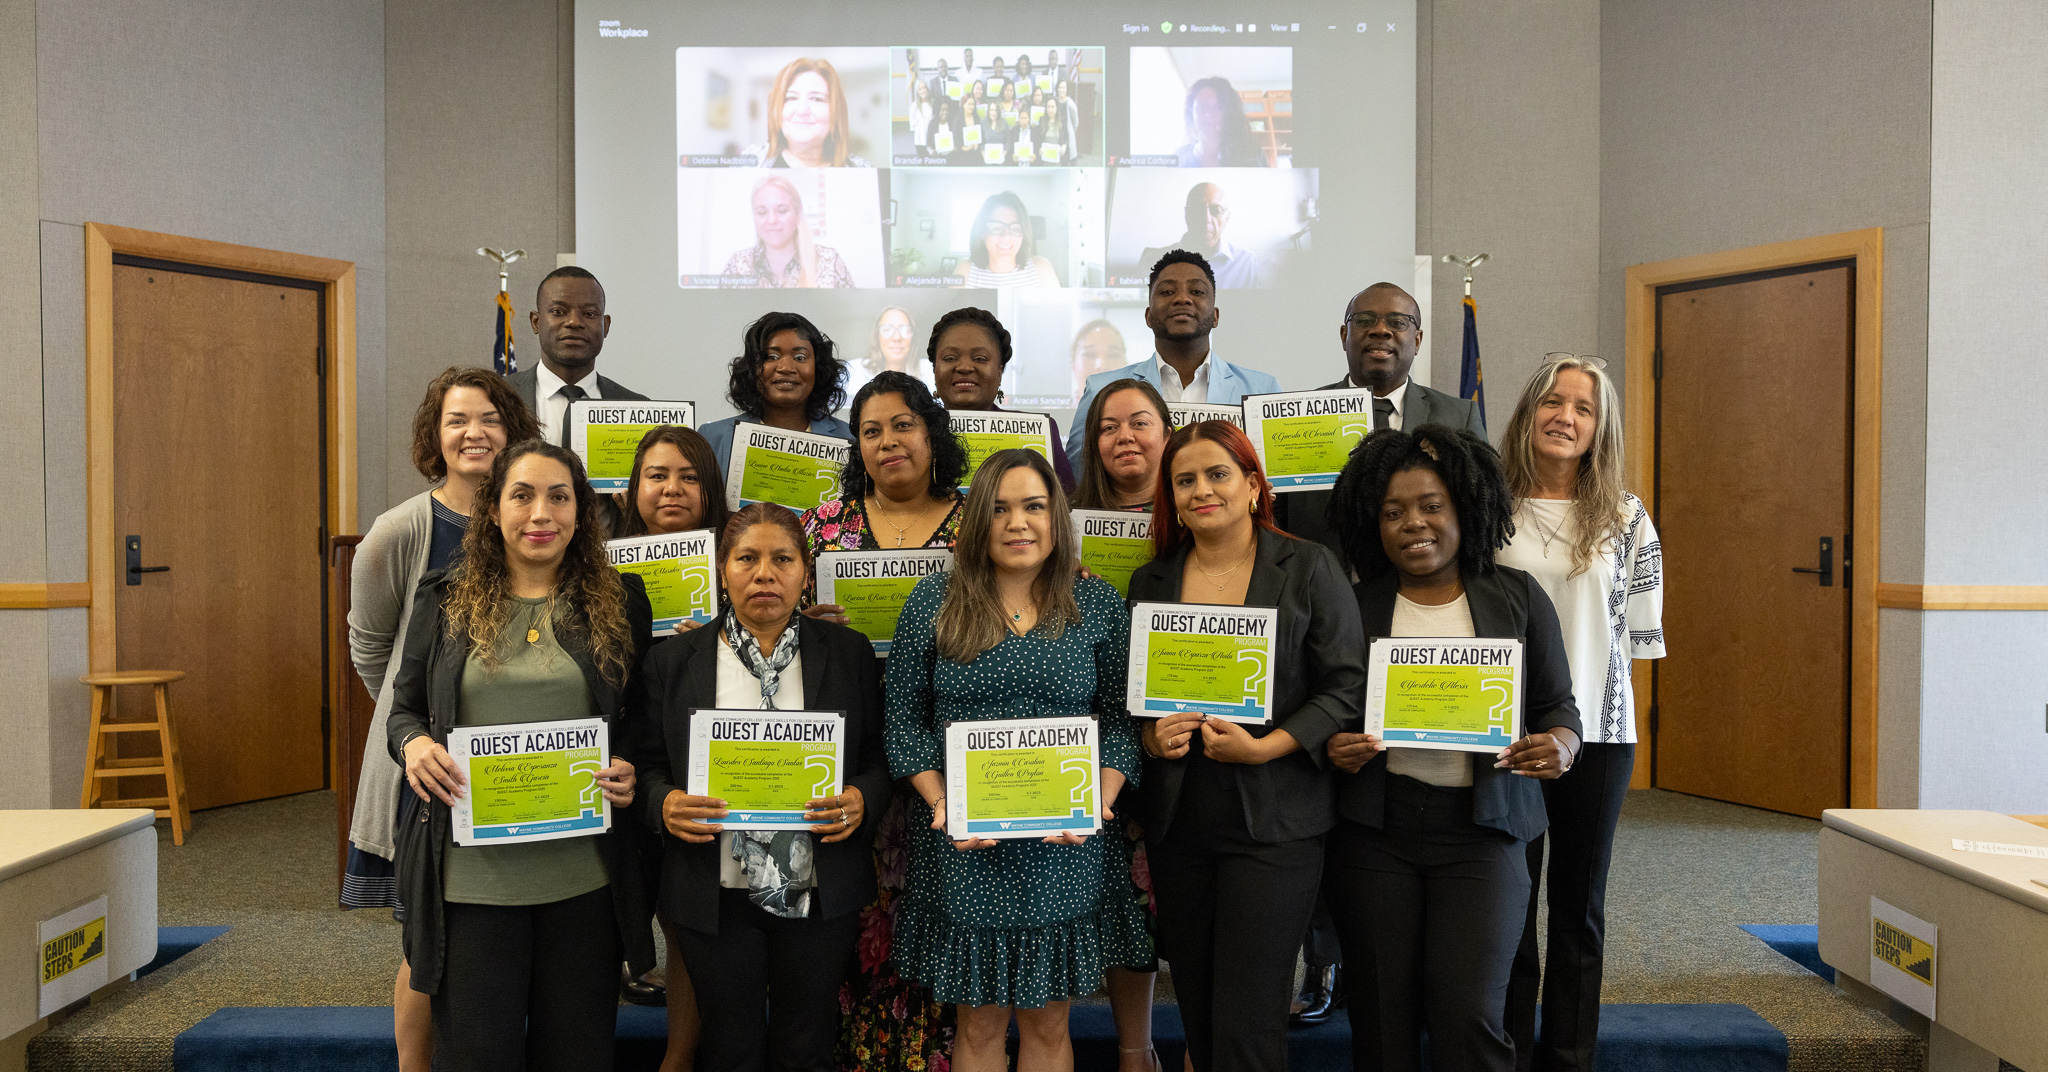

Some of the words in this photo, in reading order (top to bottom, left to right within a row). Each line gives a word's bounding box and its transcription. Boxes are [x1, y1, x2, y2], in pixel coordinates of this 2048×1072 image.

[599, 28, 648, 39] Workplace
[1122, 24, 1140, 34] Sign
[1142, 24, 1150, 32] in
[1270, 24, 1288, 32] View
[692, 156, 718, 165] Debbie
[894, 156, 922, 165] Brandie
[924, 156, 947, 165] Pavon
[1119, 157, 1146, 165] Andrea
[906, 276, 942, 286] Alejandra
[1120, 276, 1143, 285] fabian
[1262, 401, 1303, 419] QUEST
[1305, 397, 1366, 416] ACADEMY
[588, 410, 626, 424] QUEST
[630, 410, 686, 423] ACADEMY
[1170, 412, 1187, 425] EST
[1338, 414, 1366, 422] PROGRAM
[949, 418, 986, 433] QUEST
[990, 420, 1042, 434] ACADEMY
[749, 433, 786, 452] QUEST
[788, 439, 843, 461] ACADEMY
[1085, 520, 1125, 536] QUEST
[609, 547, 641, 564] UEST
[645, 540, 706, 561] ACADEMY
[678, 556, 707, 565] PROGRAM
[835, 561, 878, 579] QUEST
[881, 560, 946, 577] ACADEMY
[1151, 614, 1196, 634] QUEST
[1198, 616, 1268, 637] ACADEMY
[1234, 638, 1266, 647] PROGRAM
[1390, 648, 1436, 665] QUEST
[1439, 648, 1513, 666] ACADEMY
[1477, 668, 1512, 676] PROGRAM
[712, 722, 759, 741] QUEST
[763, 723, 835, 742] ACADEMY
[471, 735, 521, 757] QUEST
[524, 729, 599, 753] ACADEMY
[967, 731, 1014, 750] QUEST
[1018, 728, 1090, 748] ACADEMY
[565, 749, 599, 760] PROGRAM
[801, 744, 834, 752] PROGRAM
[1056, 748, 1089, 756] PROGRAM
[45, 928, 84, 962] CAUTION
[1876, 922, 1912, 955] CAUTION
[1876, 938, 1900, 966] STEPS
[45, 952, 74, 980] STEPS
